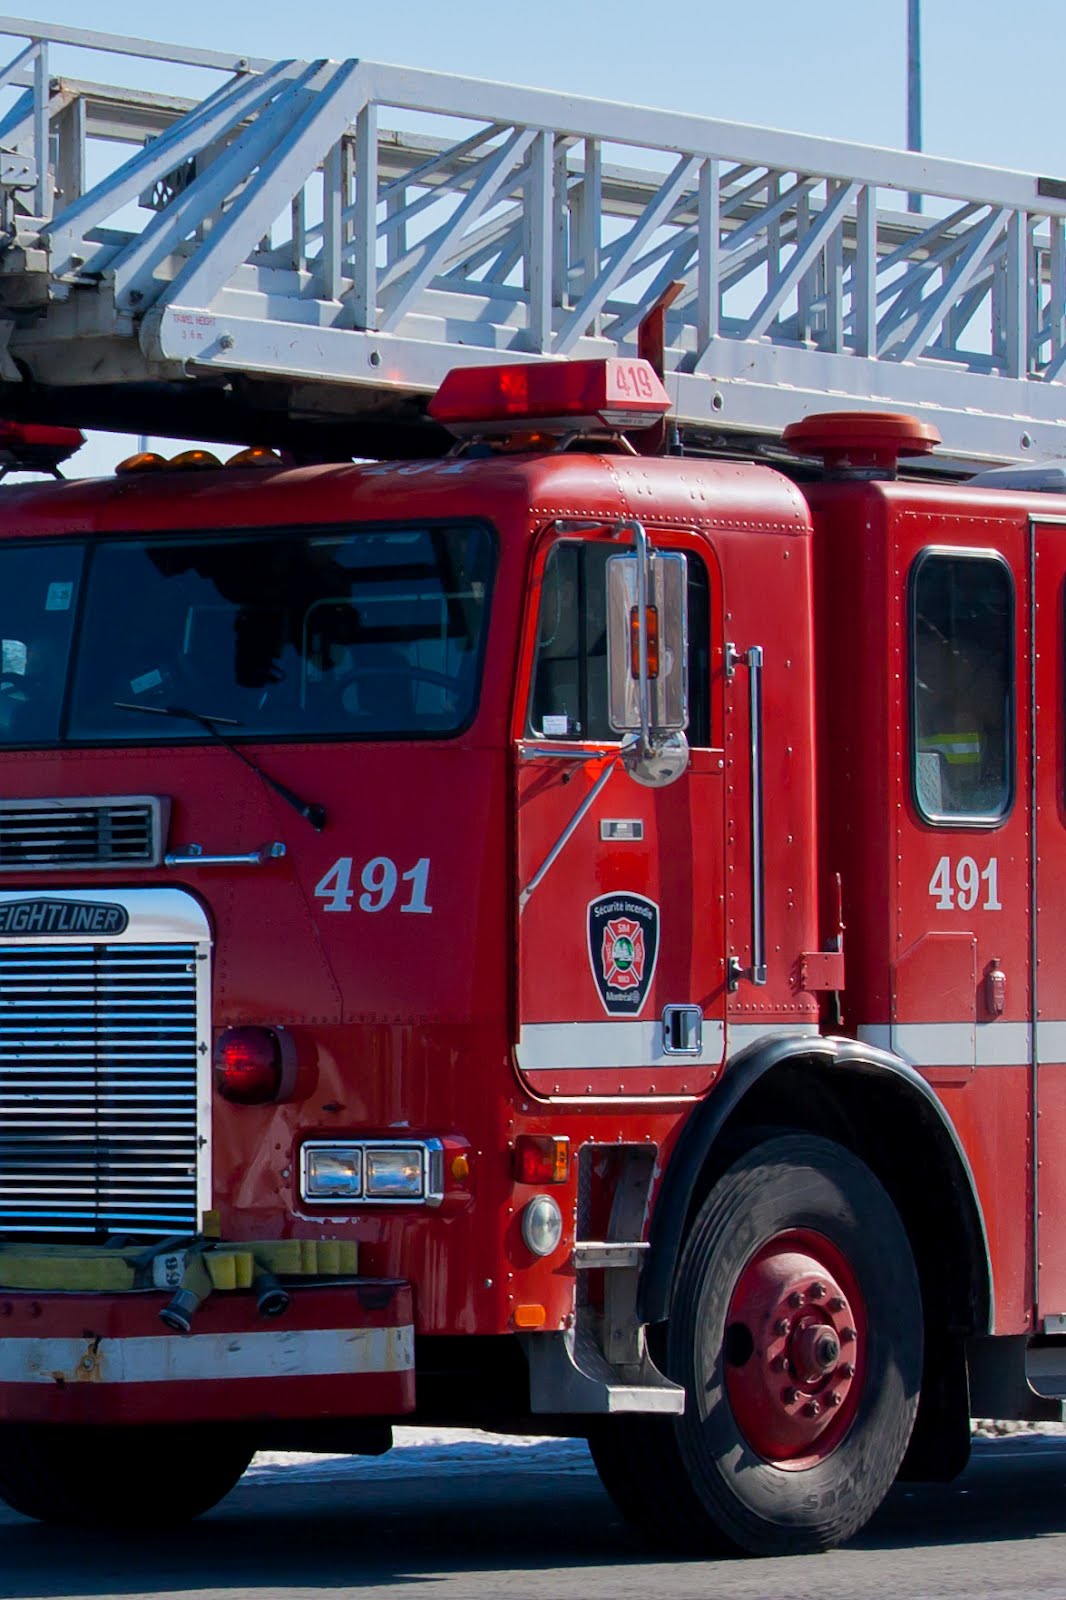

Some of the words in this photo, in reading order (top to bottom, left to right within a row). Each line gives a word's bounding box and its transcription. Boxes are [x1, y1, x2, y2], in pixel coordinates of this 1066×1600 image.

[173, 313, 194, 325] TRAVEL
[195, 316, 216, 326] HEIGHT
[616, 364, 653, 398] 419
[314, 856, 433, 914] 491
[928, 856, 1003, 911] 491
[594, 901, 624, 918] Sécurité
[624, 901, 653, 920] incendie
